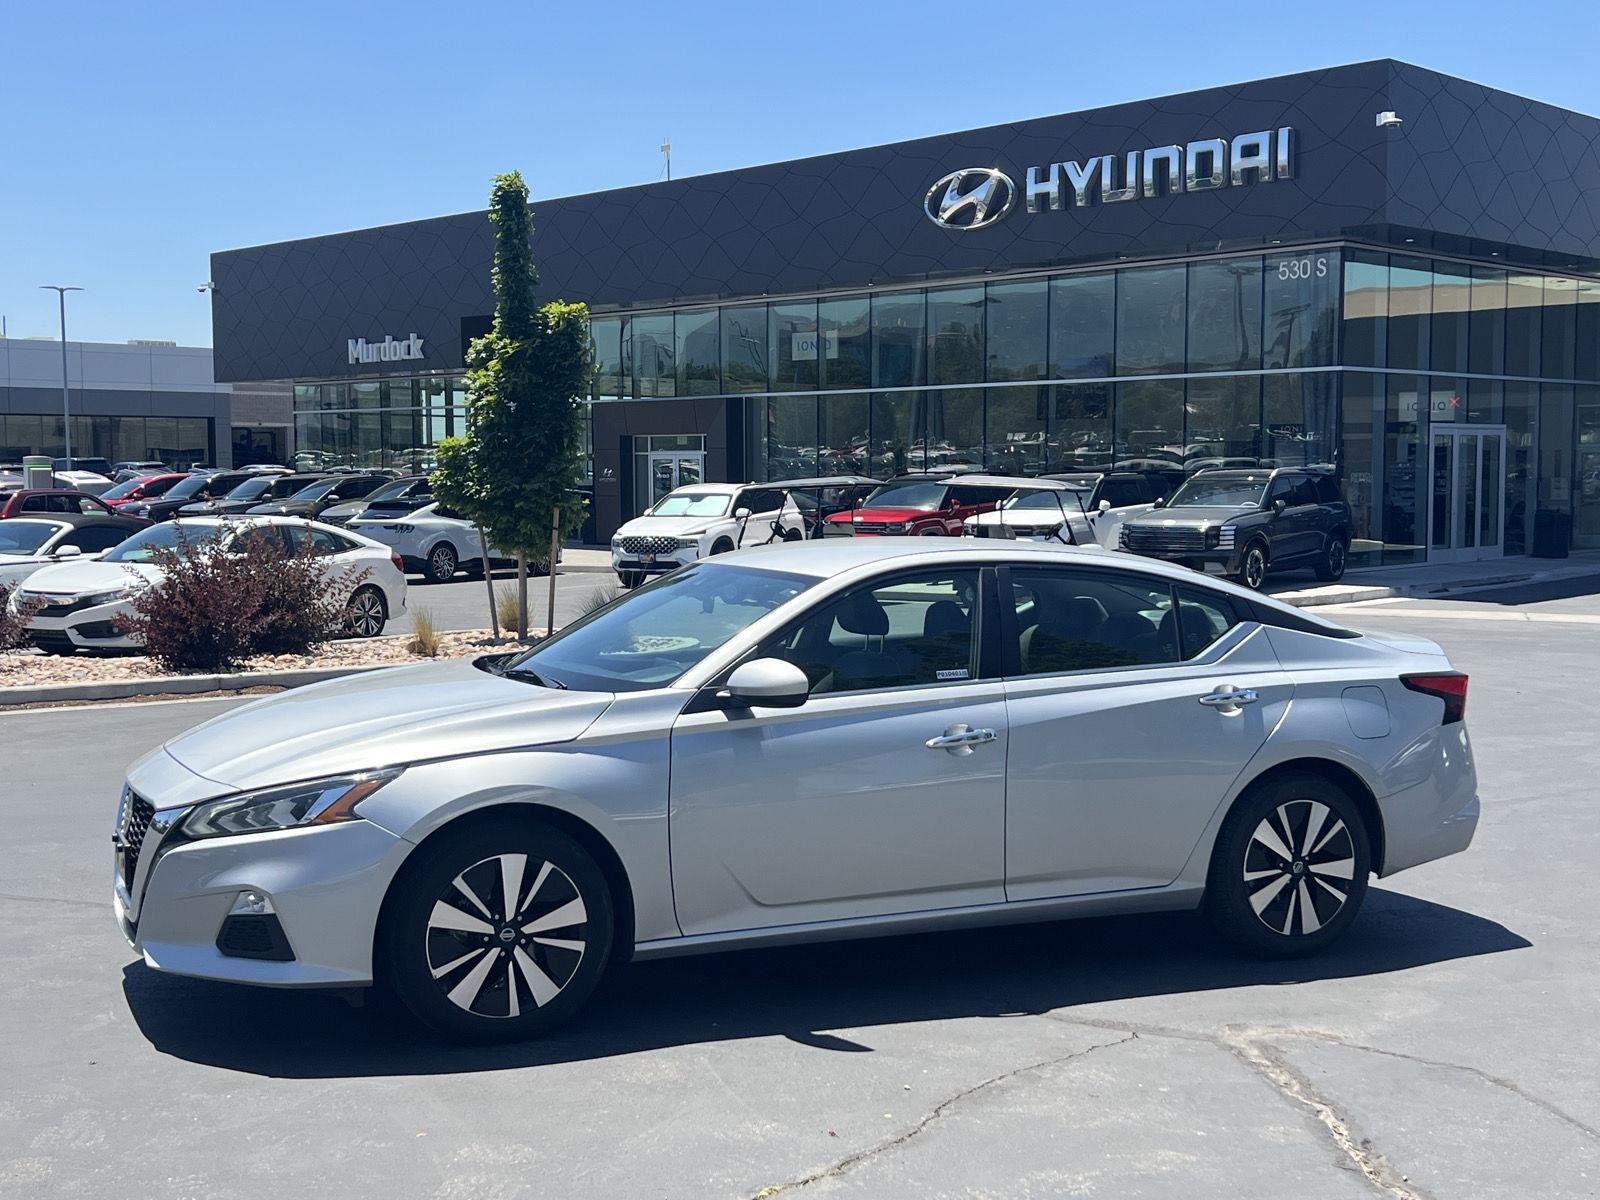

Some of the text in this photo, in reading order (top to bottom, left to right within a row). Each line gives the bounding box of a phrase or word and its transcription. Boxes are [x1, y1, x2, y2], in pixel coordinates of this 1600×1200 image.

[1025, 126, 1296, 214] HYUNDAI
[1278, 258, 1327, 280] 530 S
[347, 333, 424, 364] Murdock
